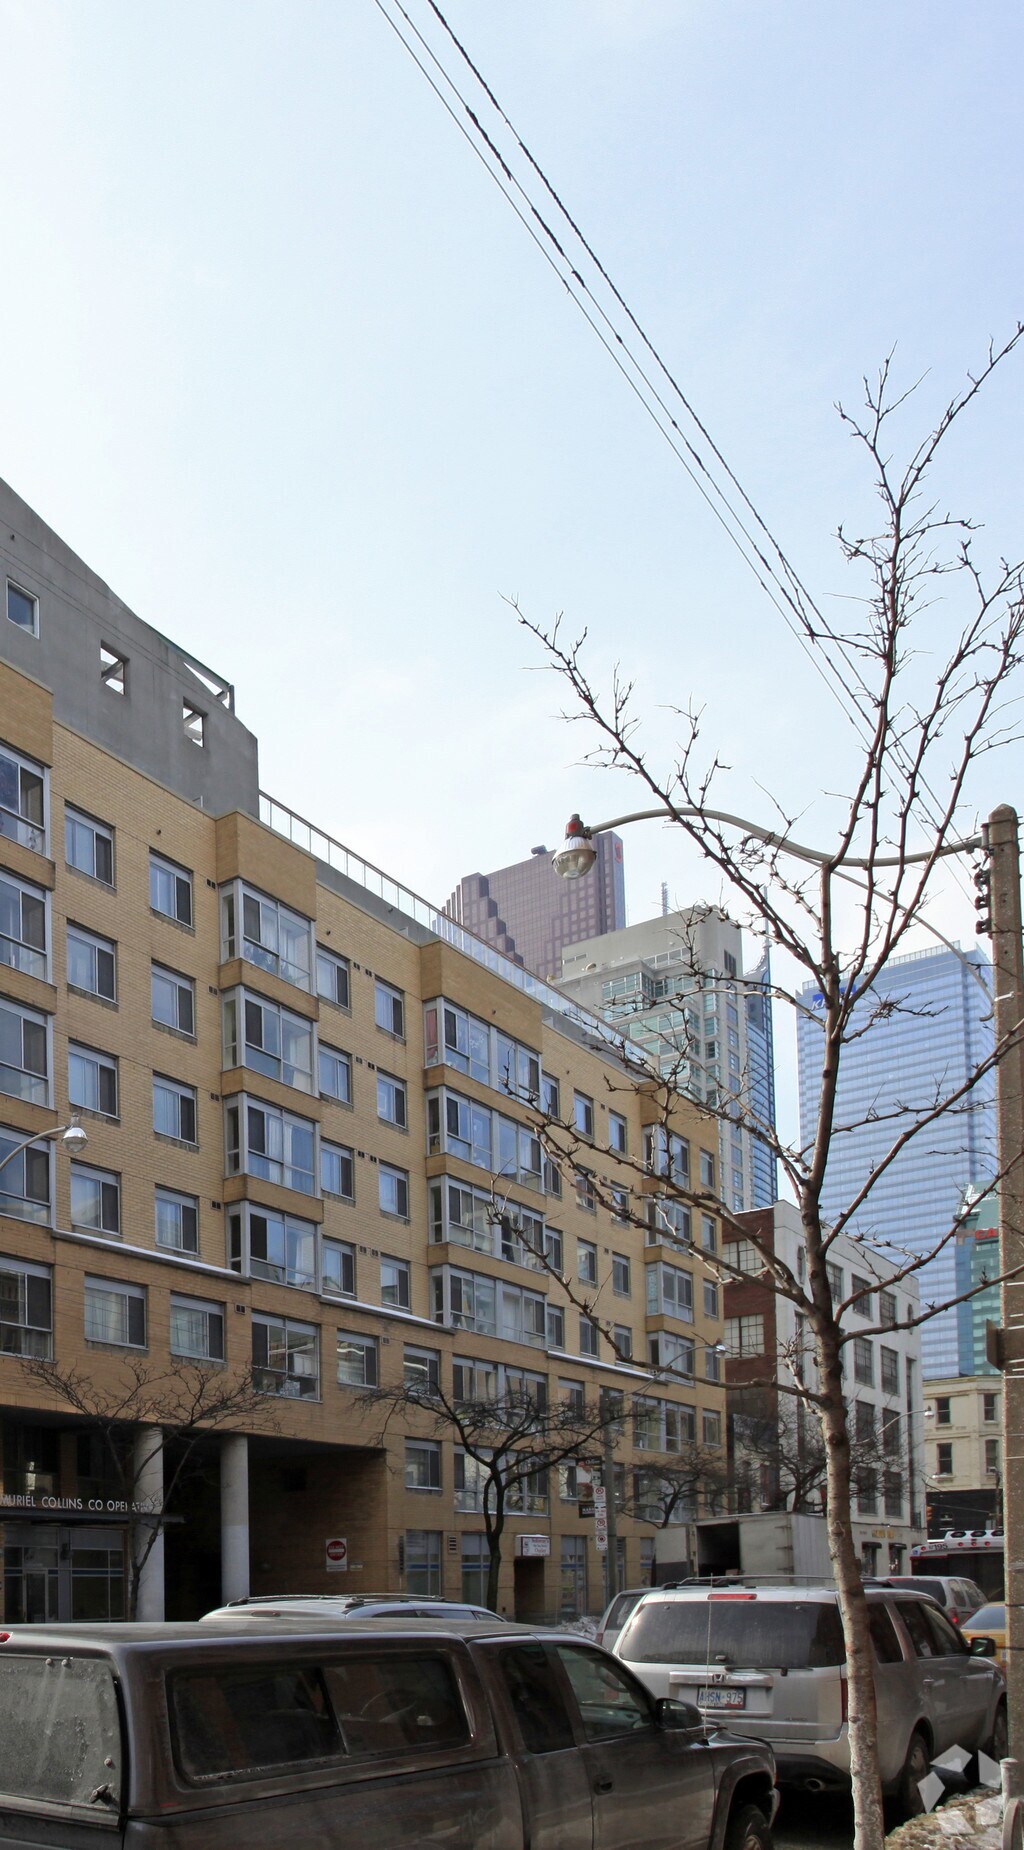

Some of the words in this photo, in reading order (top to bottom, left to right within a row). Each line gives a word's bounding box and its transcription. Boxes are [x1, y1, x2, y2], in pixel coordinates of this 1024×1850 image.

[0, 1494, 37, 1507] MURIEL
[41, 1496, 83, 1510] COLLINS
[88, 1499, 103, 1511] CO
